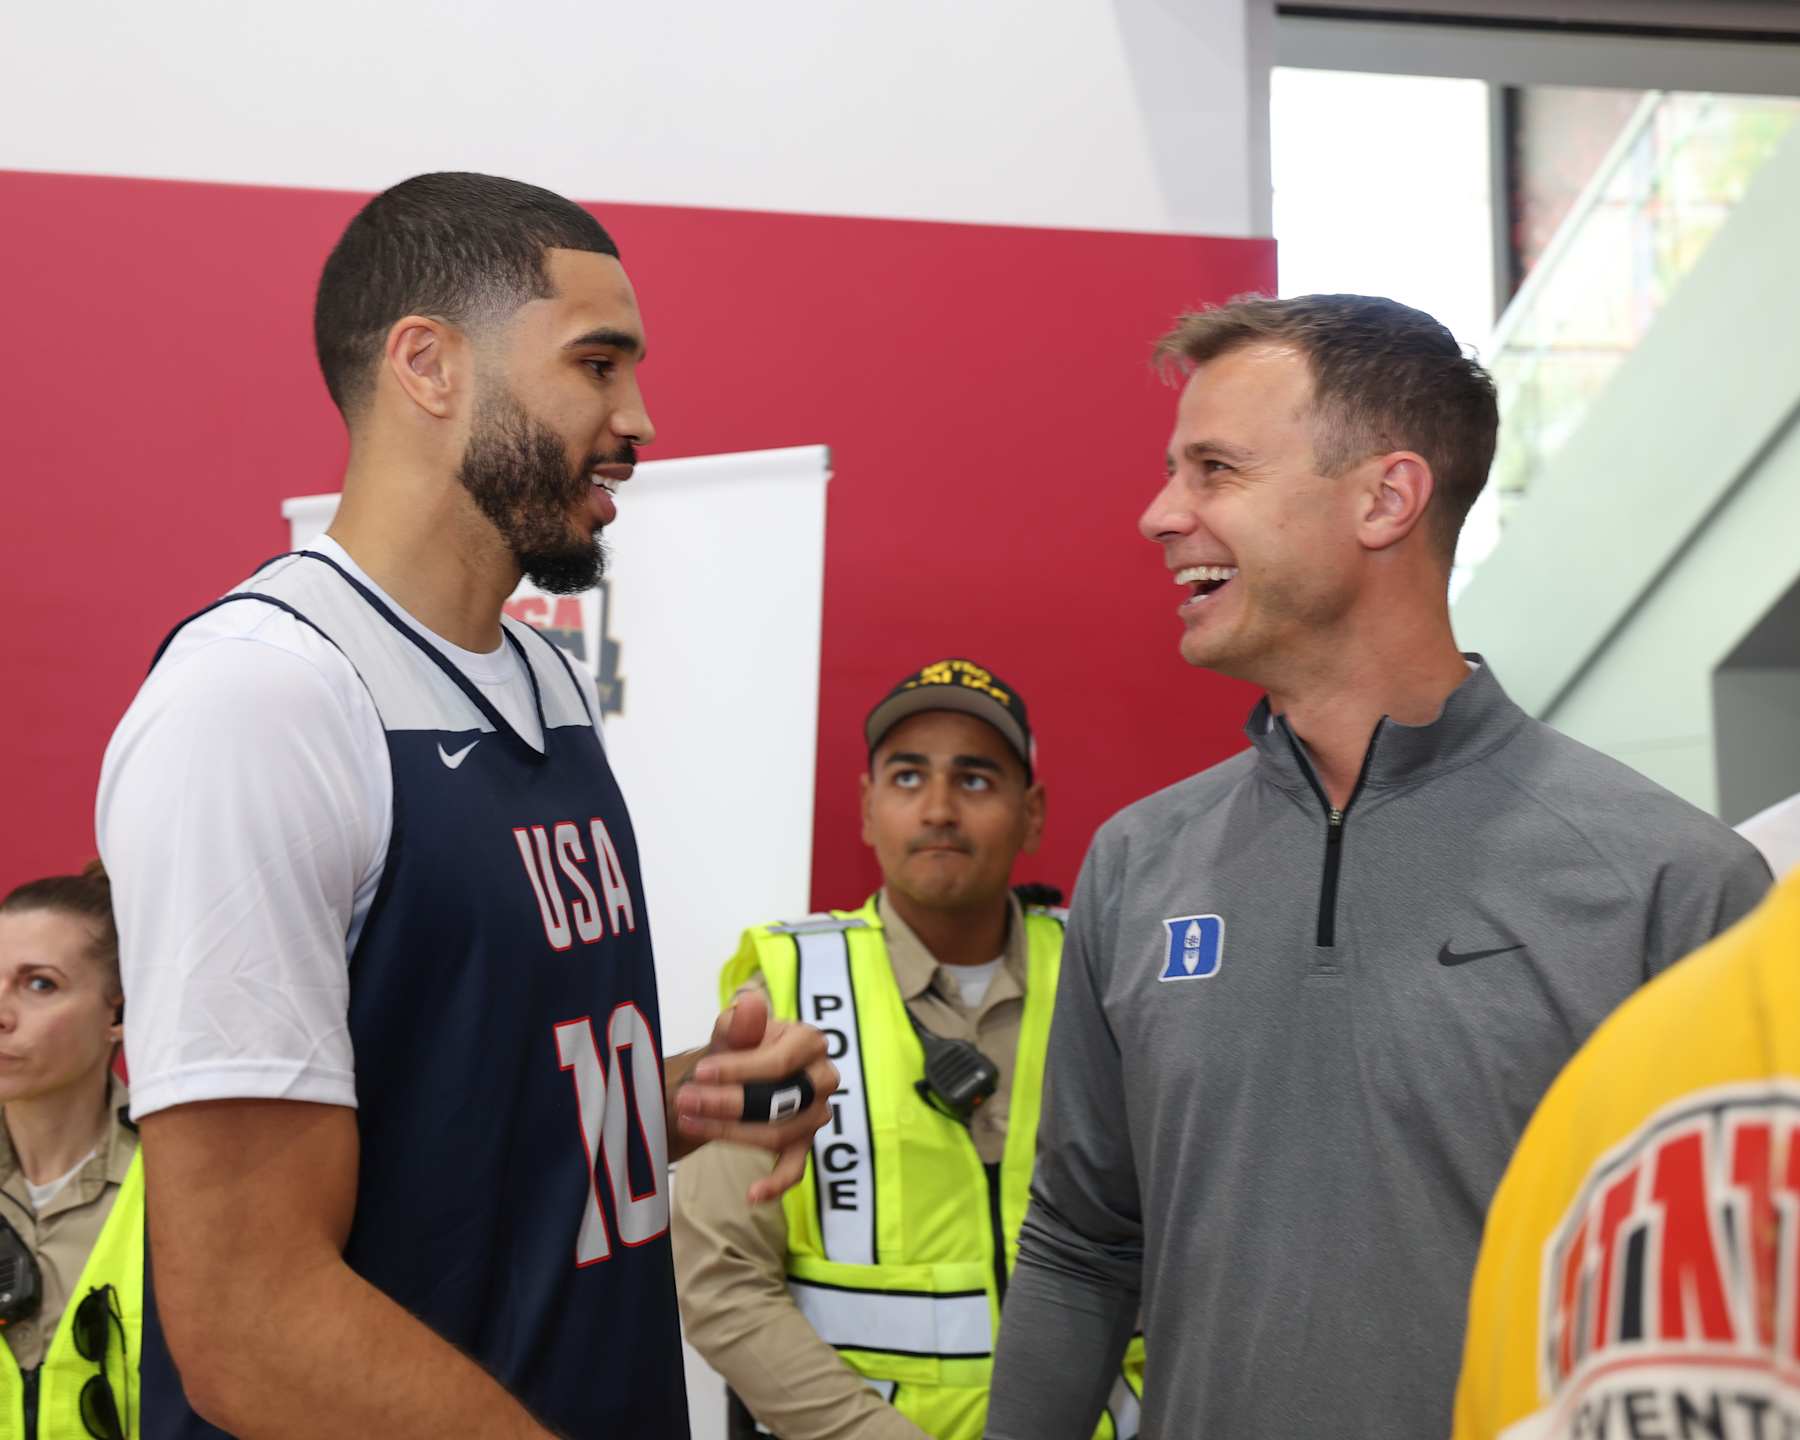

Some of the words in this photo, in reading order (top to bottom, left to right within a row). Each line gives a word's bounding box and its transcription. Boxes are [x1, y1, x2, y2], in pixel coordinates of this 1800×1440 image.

[512, 817, 635, 952] USA
[553, 1000, 669, 1268] 10
[812, 994, 859, 1212] POICE
